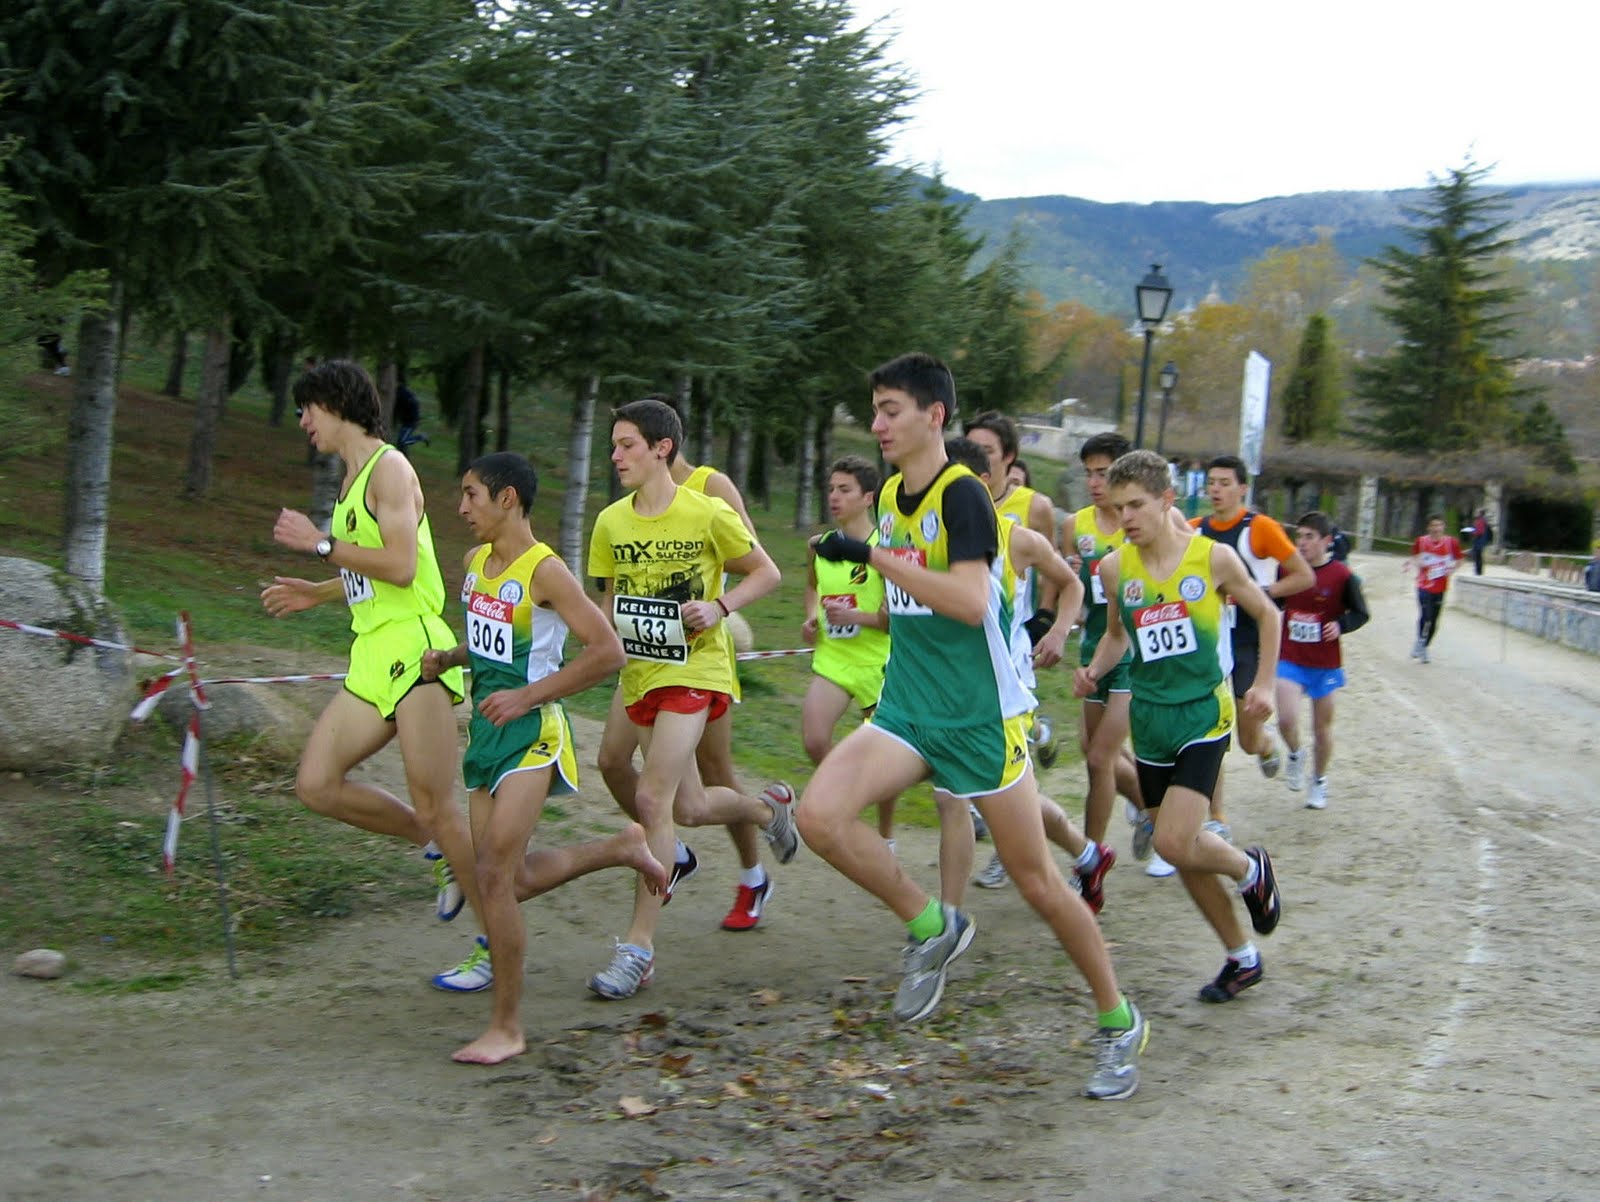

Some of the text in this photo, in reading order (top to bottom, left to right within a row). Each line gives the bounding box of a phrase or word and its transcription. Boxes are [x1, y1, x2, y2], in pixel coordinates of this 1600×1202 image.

[620, 602, 666, 616] KELME
[473, 619, 505, 656] 306
[631, 617, 667, 646] 133
[1147, 624, 1188, 654] 305
[625, 642, 669, 657] KELME
